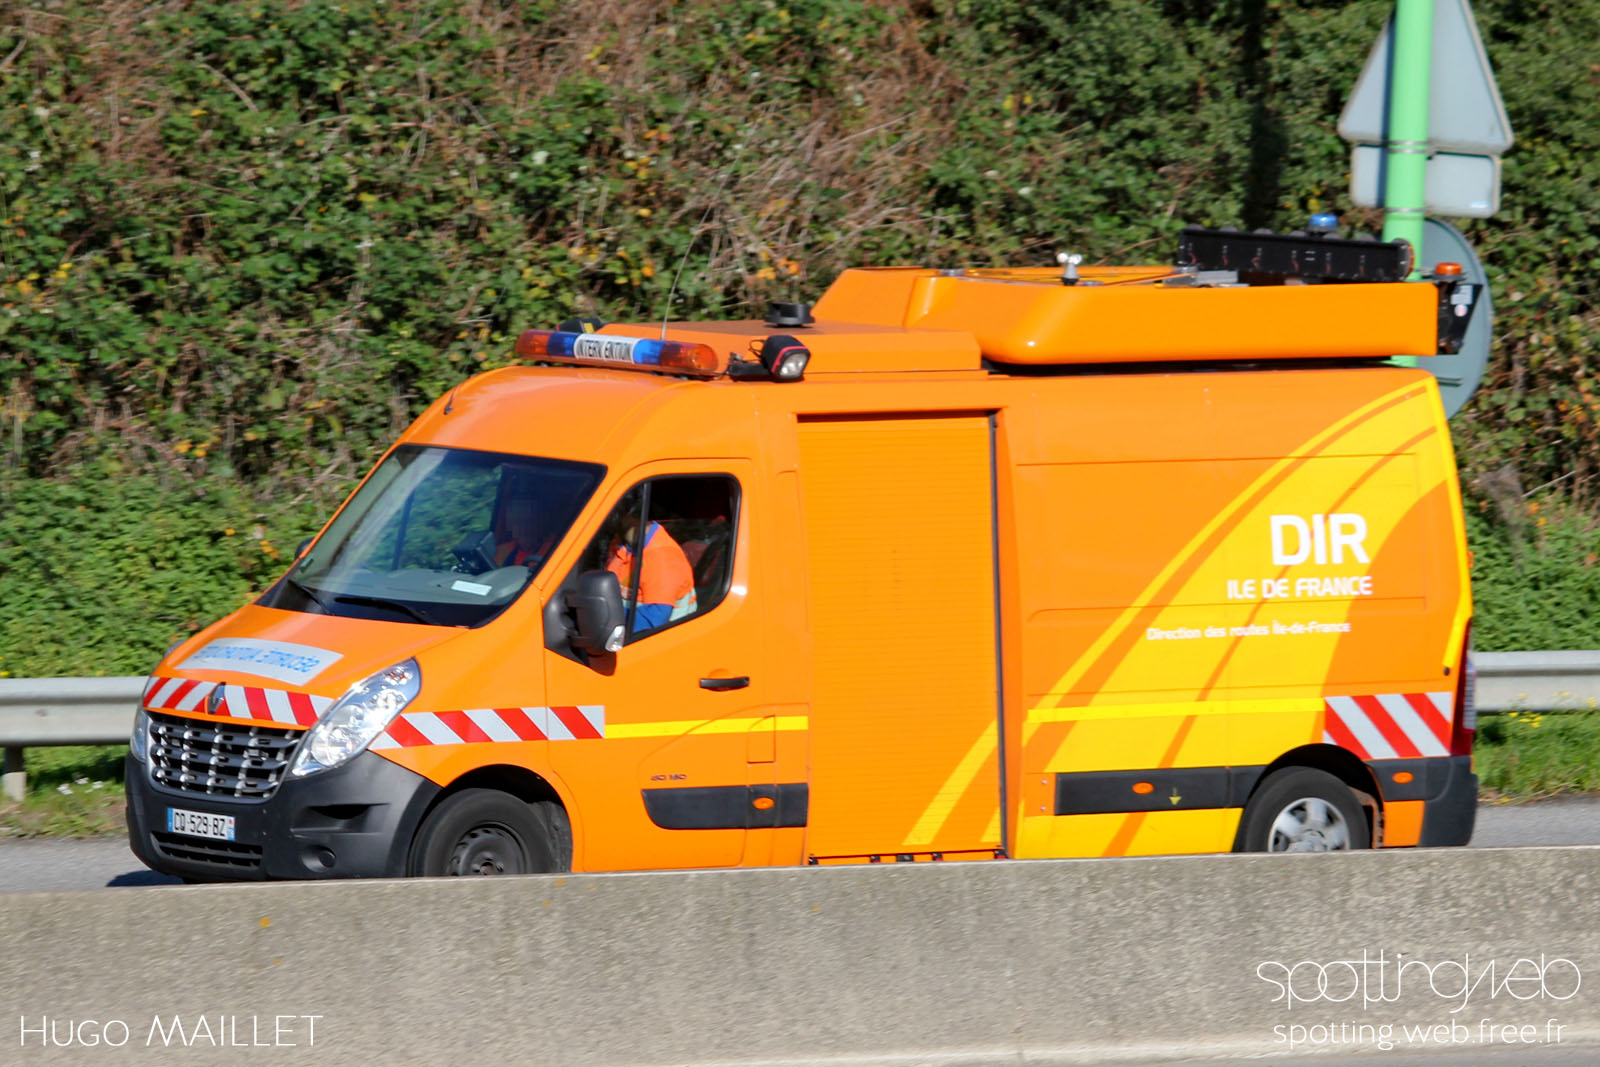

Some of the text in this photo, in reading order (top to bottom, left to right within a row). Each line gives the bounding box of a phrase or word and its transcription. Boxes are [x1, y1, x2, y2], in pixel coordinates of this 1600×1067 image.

[1269, 512, 1370, 566] DIR
[1226, 575, 1373, 599] ILE DE FRANCE
[1146, 626, 1202, 641] Direction
[1204, 625, 1227, 638] des
[1229, 624, 1270, 637] routes
